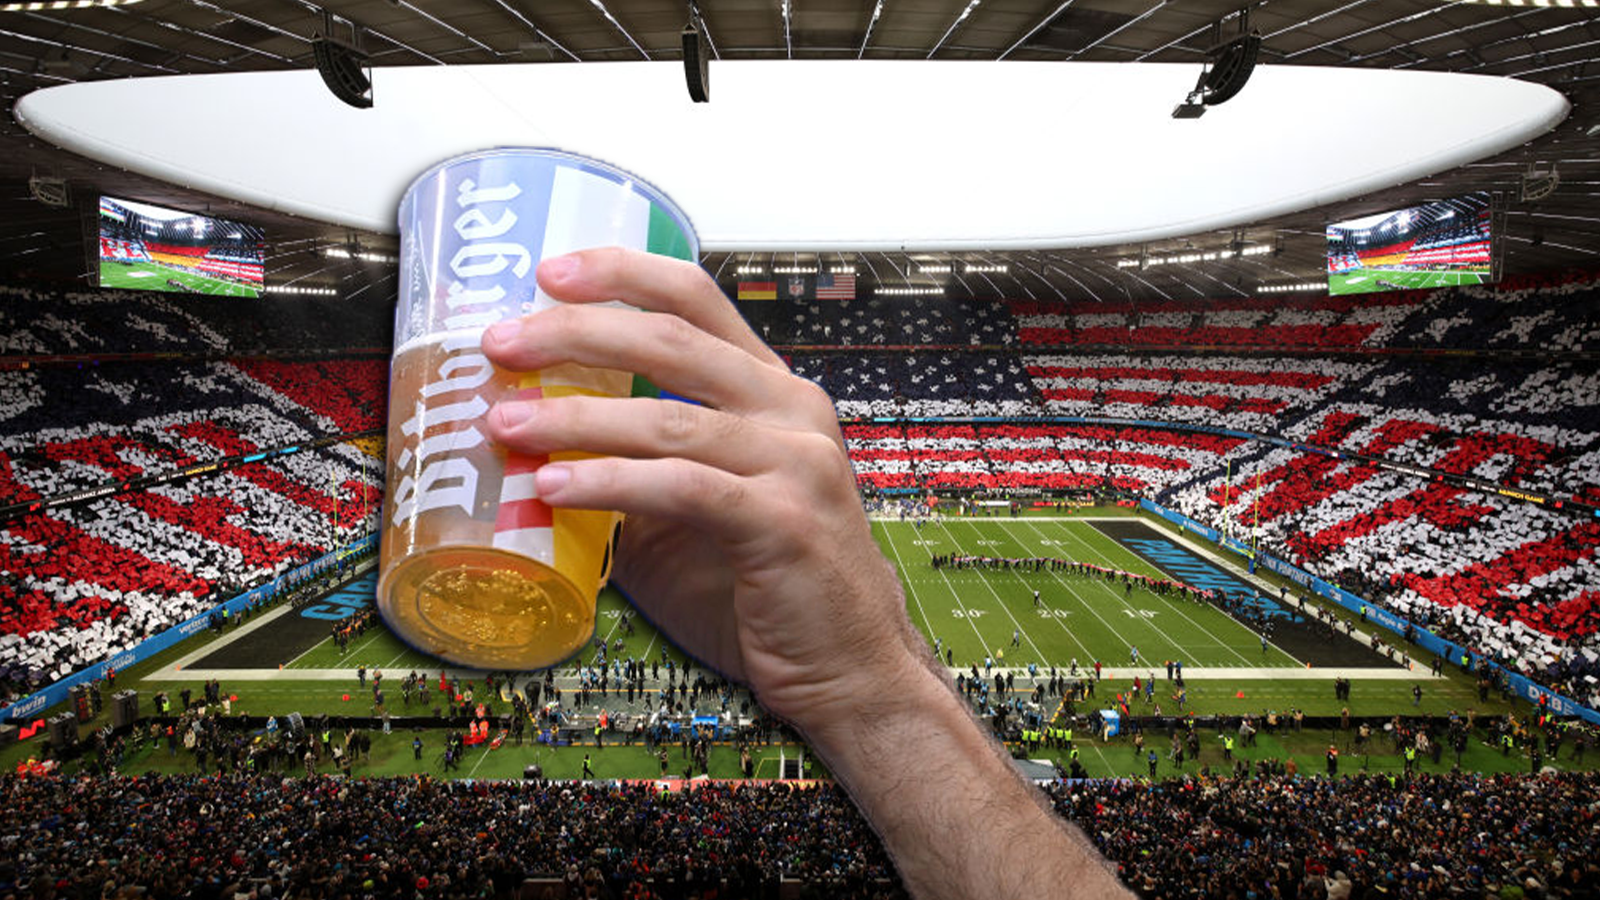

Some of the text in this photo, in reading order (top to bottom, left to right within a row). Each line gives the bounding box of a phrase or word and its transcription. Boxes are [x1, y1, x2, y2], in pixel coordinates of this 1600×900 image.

[393, 178, 531, 528] Bitburger
[179, 615, 210, 634] verizon
[12, 694, 47, 718] bwin
